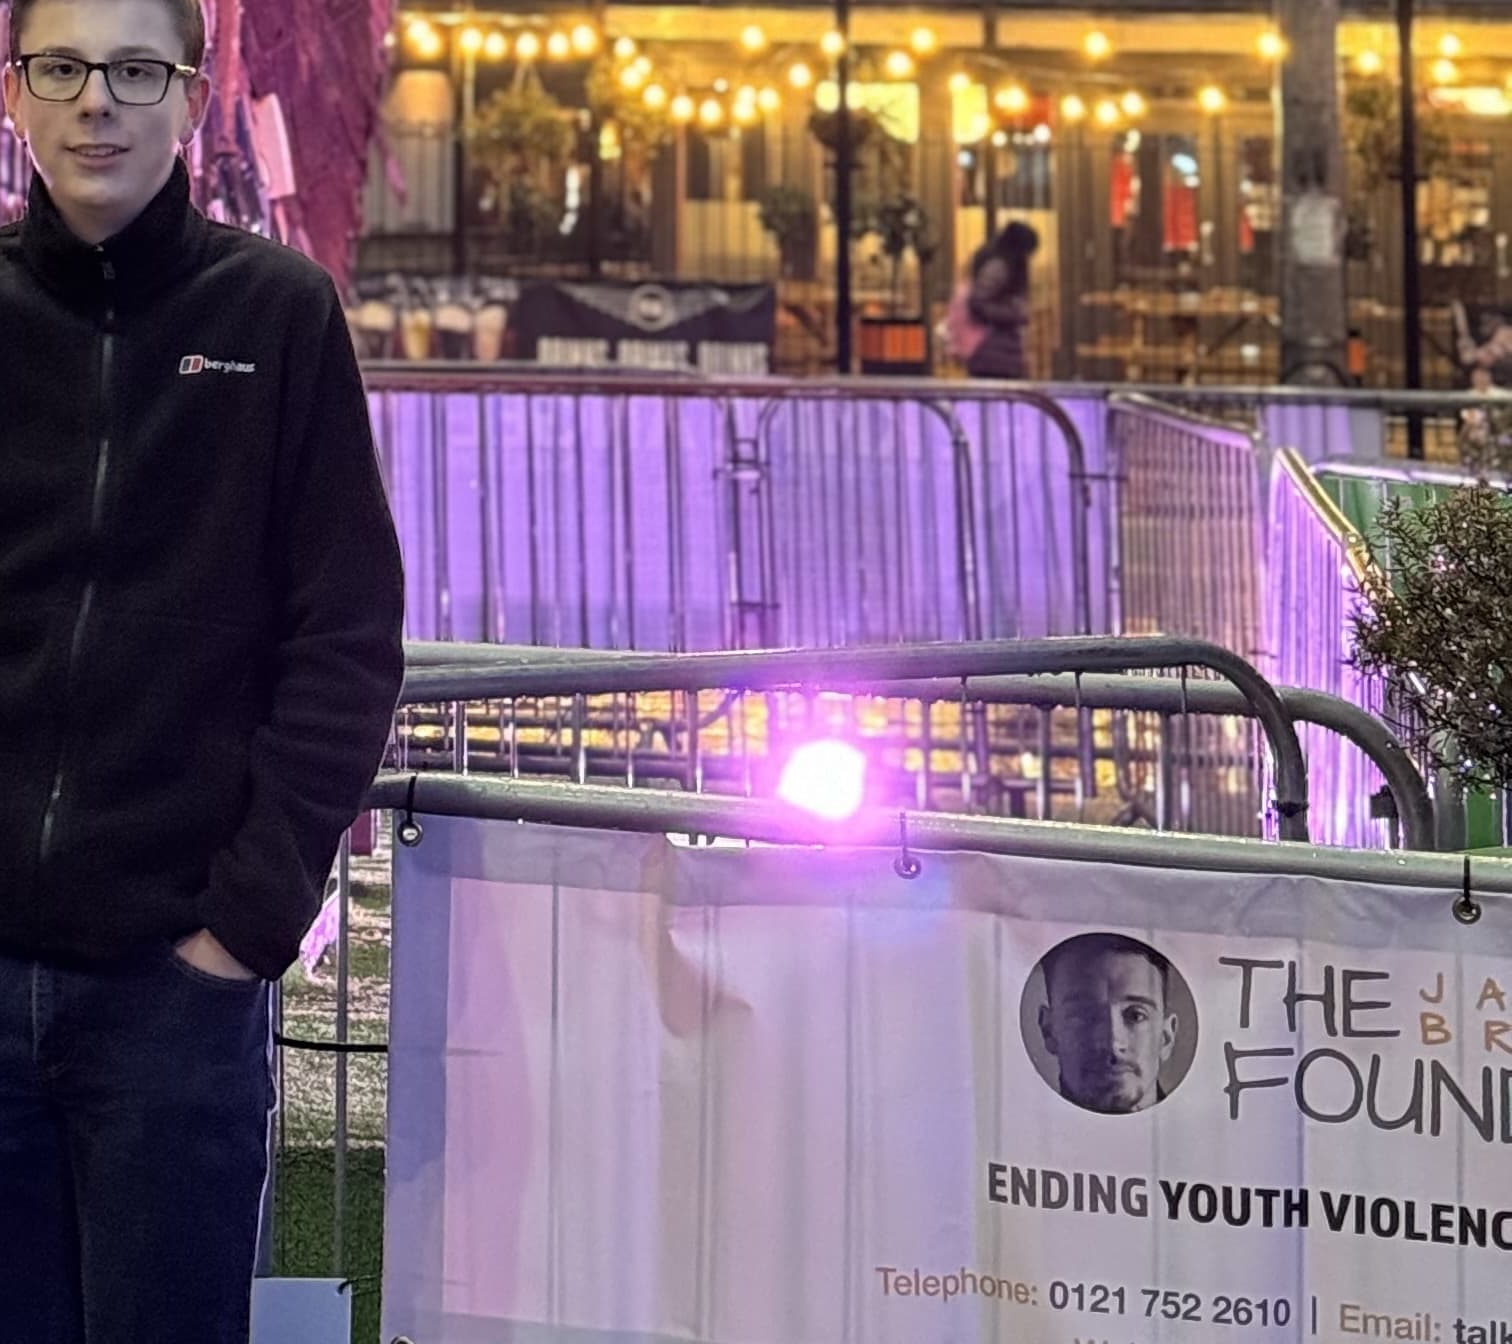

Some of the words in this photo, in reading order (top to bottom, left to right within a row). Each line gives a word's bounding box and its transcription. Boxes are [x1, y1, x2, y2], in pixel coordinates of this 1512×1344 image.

[1218, 956, 1401, 1037] THE
[1223, 1041, 1512, 1144] FOUN
[988, 1162, 1148, 1217] ENDING
[1159, 1179, 1310, 1228] YOUTH
[1319, 1190, 1512, 1251] VIOLENC
[875, 1267, 1038, 1306] Telephone:
[1049, 1280, 1126, 1315] 0121
[1141, 1288, 1202, 1321] 752
[1212, 1293, 1290, 1326] 2610
[1339, 1303, 1442, 1343] Email:
